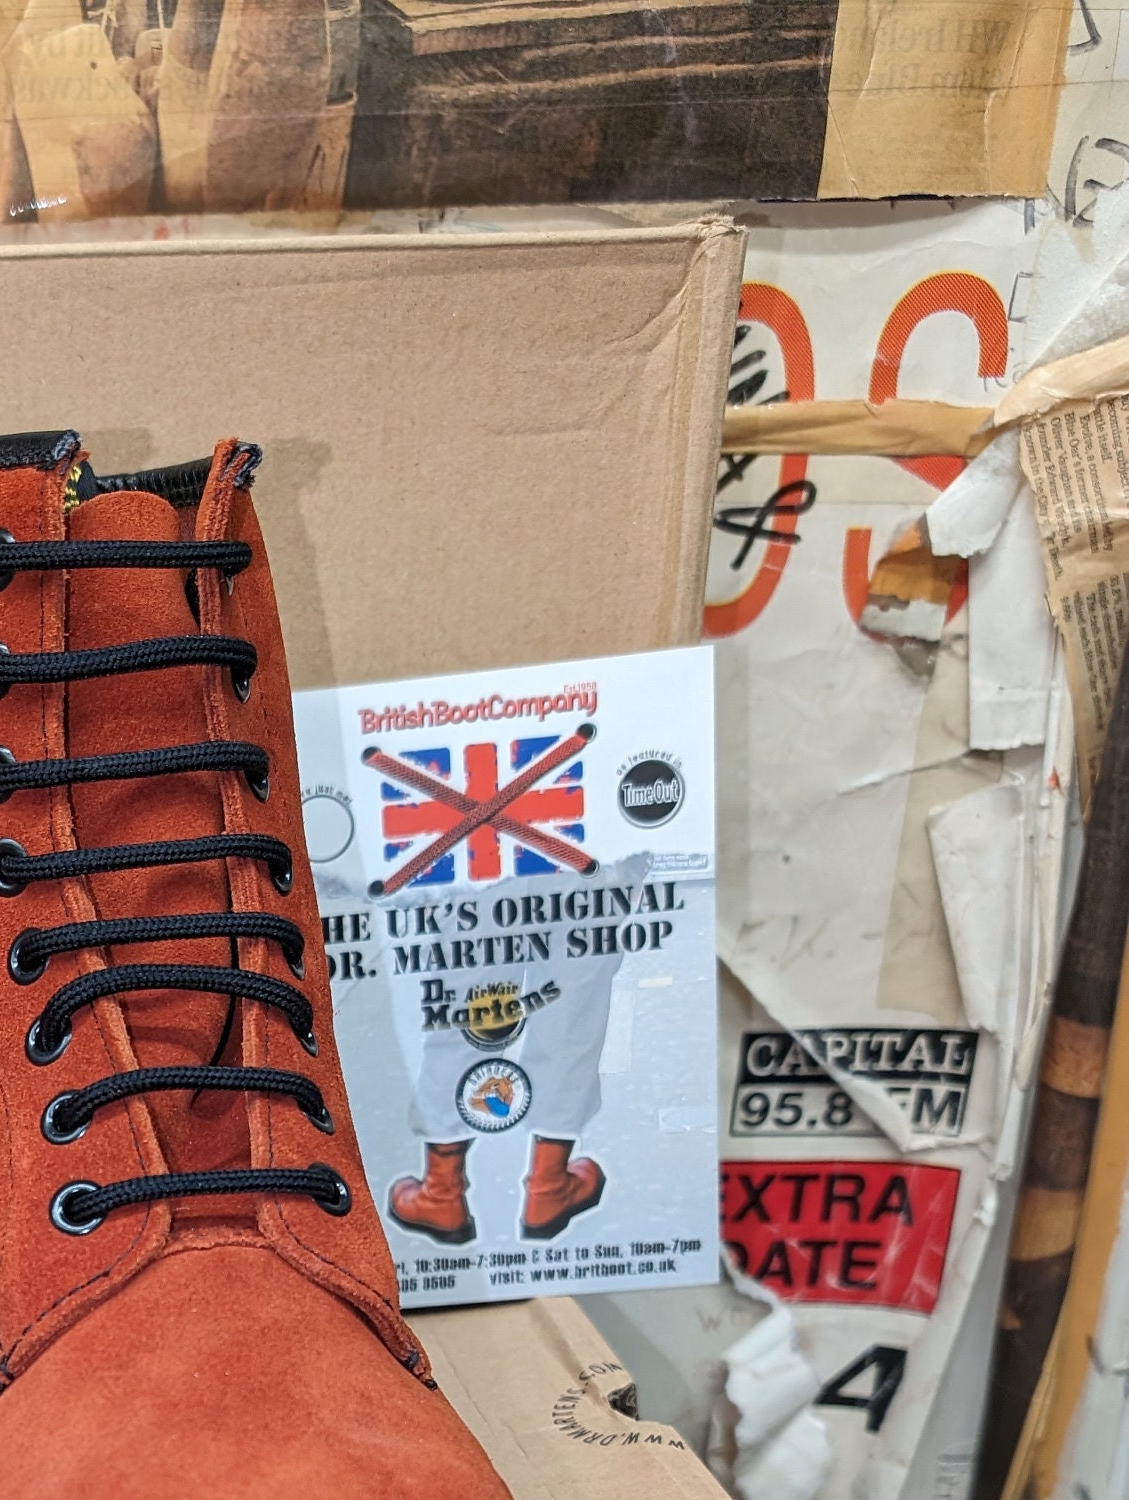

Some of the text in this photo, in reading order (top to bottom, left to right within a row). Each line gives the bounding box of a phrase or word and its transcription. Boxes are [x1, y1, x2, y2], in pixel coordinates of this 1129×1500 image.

[357, 690, 597, 735] BritishBootCompany
[321, 881, 685, 945] HE UK'S ORIGINAL
[393, 931, 551, 975] MARTEN
[566, 920, 673, 958] SHOP
[420, 978, 519, 1004] Dr. AirWair
[421, 980, 562, 1032] Martens
[746, 1034, 970, 1077] CAPITAL
[739, 1091, 853, 1129] 95.8
[720, 1173, 914, 1227] XTRA
[530, 1257, 677, 1282] www.britboot.co.uk
[545, 1247, 569, 1263] Sat
[575, 1247, 589, 1261] to
[594, 1244, 624, 1260] Sun,
[630, 1238, 701, 1256] 10am-7pm
[813, 1344, 908, 1434] 4
